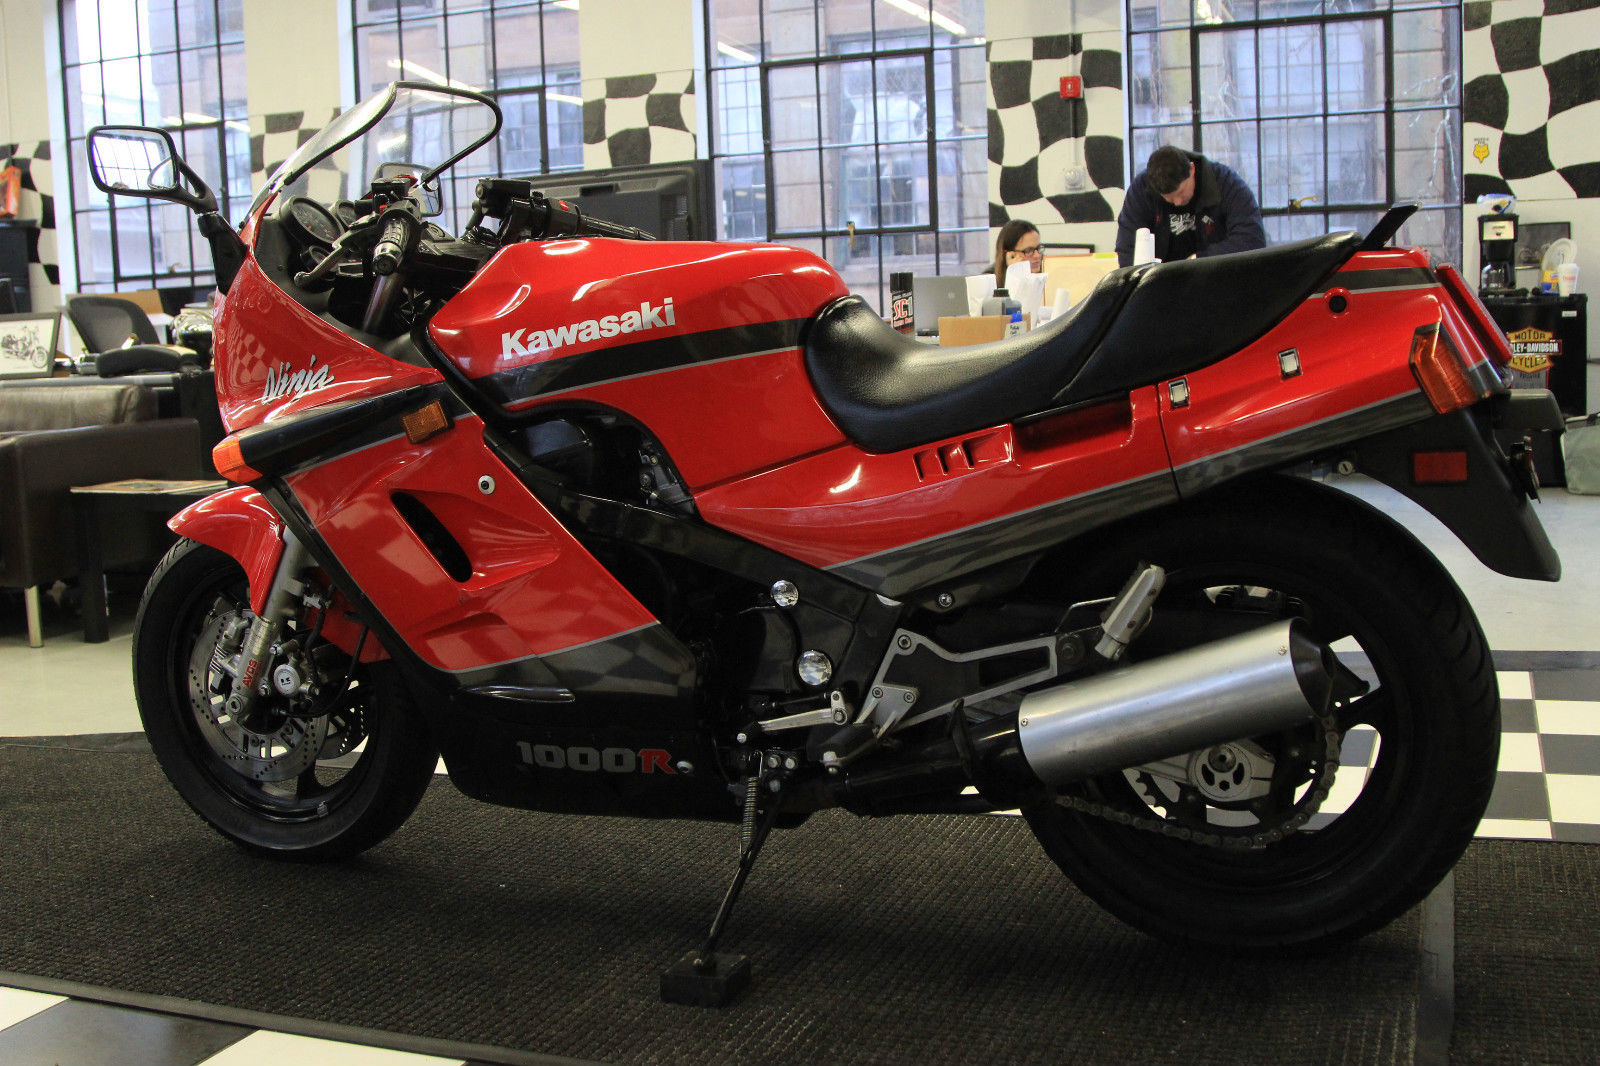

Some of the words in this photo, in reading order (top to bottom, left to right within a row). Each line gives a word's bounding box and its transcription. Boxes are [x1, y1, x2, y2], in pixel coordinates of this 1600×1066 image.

[893, 296, 913, 320] SC1
[501, 297, 676, 360] Kawasaki
[1514, 329, 1546, 340] MOTOR
[1510, 342, 1559, 353] LEY-DAVIDSON
[1512, 355, 1548, 368] CYCLES
[261, 354, 335, 403] Ninja
[516, 741, 678, 774] 1000R
